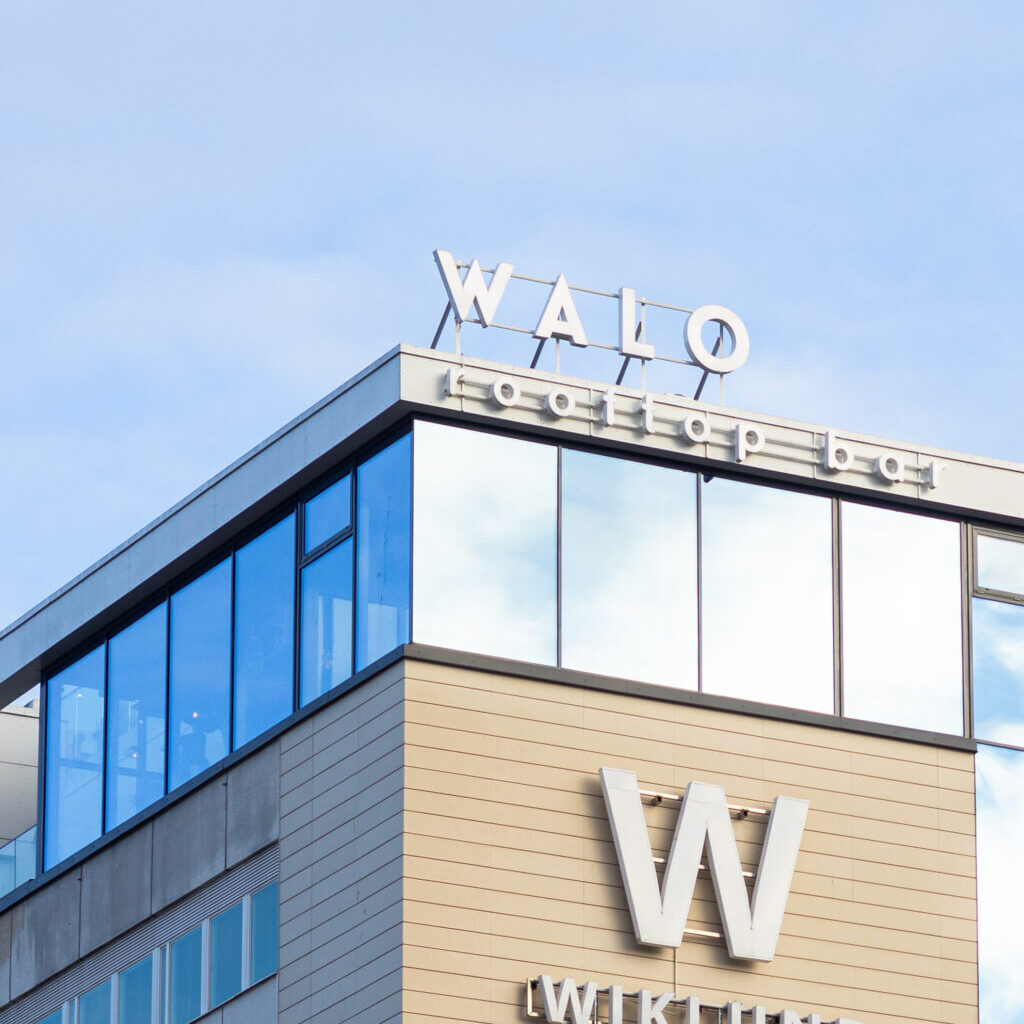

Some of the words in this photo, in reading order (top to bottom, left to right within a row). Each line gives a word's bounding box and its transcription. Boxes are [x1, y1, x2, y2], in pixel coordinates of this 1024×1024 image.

[433, 249, 750, 374] WALO
[444, 367, 766, 463] rooftop
[823, 430, 948, 489] bar
[599, 766, 810, 963] W
